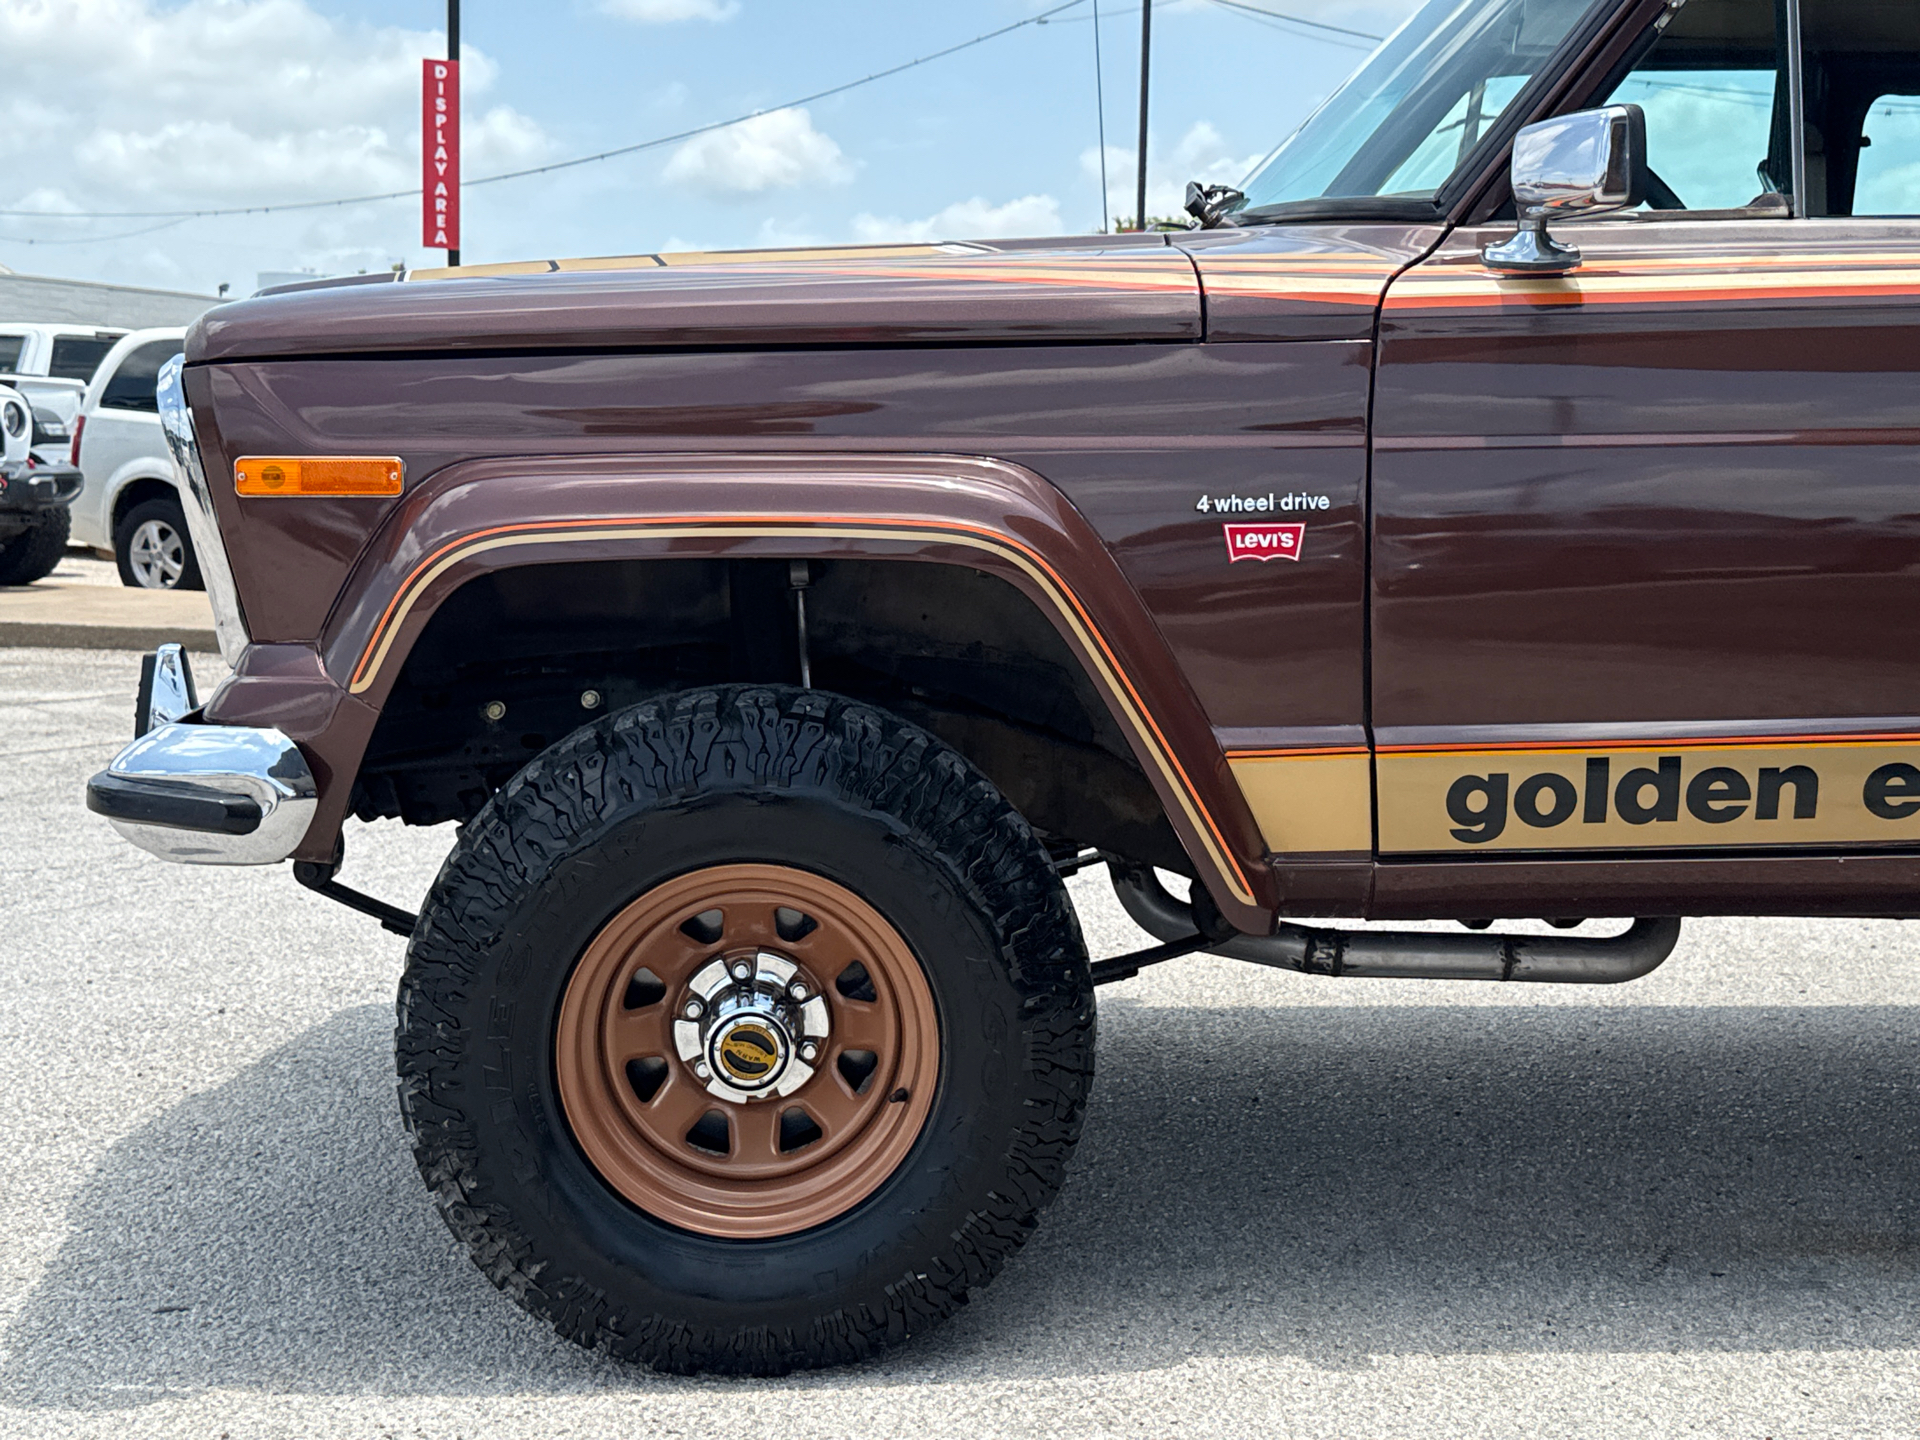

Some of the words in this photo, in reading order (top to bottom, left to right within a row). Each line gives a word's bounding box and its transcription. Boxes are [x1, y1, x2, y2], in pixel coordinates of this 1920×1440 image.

[434, 65, 448, 176] DISPLAY
[434, 182, 448, 245] AREA
[1196, 494, 1210, 513] 4
[1214, 493, 1275, 513] wheel
[1280, 492, 1331, 511] drive
[1446, 756, 1819, 844] golden
